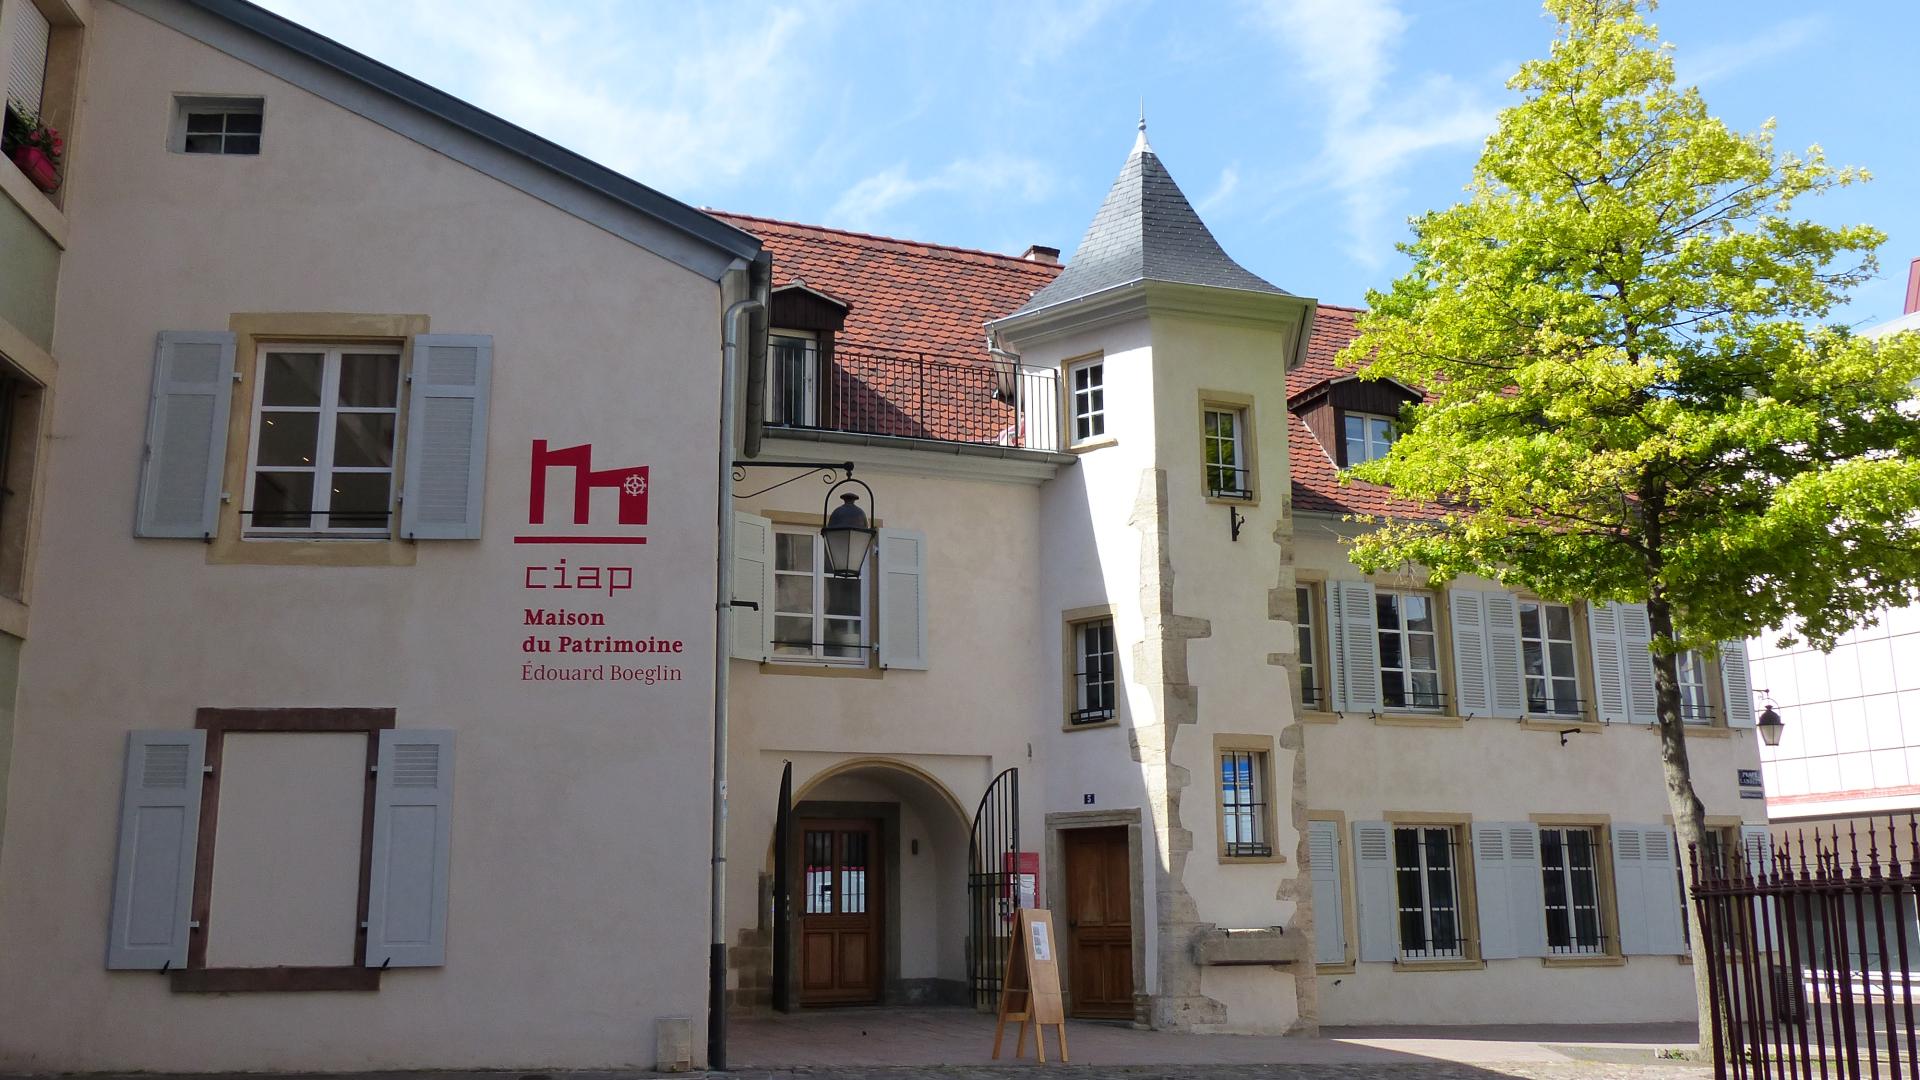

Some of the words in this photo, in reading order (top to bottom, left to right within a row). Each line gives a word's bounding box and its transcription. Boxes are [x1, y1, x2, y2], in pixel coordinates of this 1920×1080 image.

[525, 558, 633, 597] ciap
[523, 607, 605, 626] Maison
[522, 635, 551, 653] du
[558, 636, 683, 653] Patrimoine
[520, 660, 604, 681] Édouard
[610, 664, 682, 686] Boeglin
